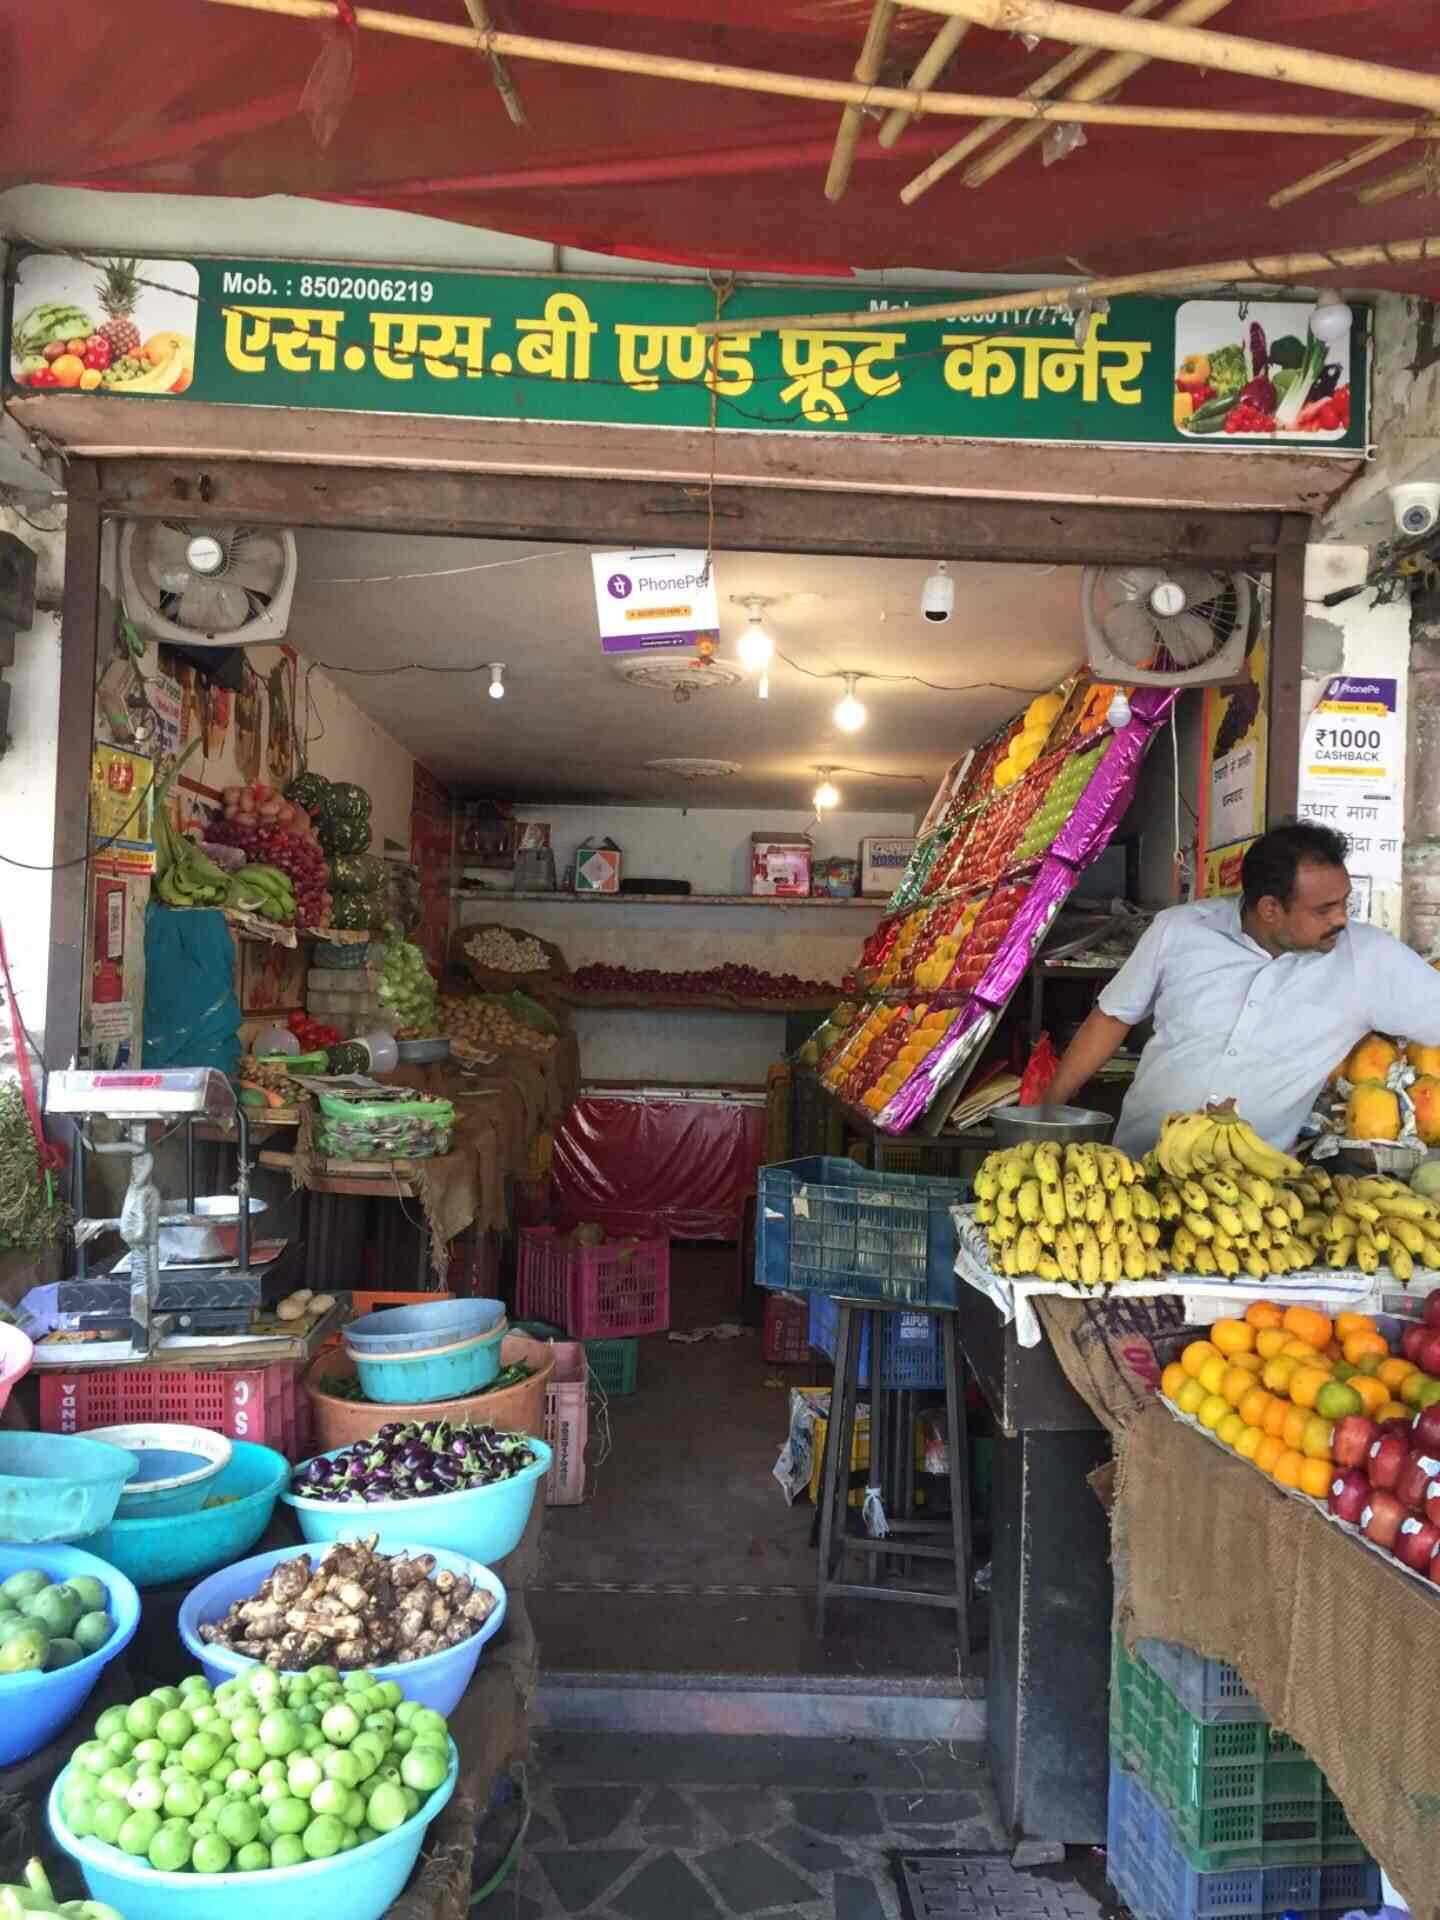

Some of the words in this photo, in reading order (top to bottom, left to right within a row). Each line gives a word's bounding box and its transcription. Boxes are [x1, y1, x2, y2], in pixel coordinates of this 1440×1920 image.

[223, 272, 278, 296] Mob.
[300, 276, 433, 302] 8502006219
[615, 323, 762, 397] एण्ड
[942, 313, 1151, 405] कार्नर
[638, 575, 705, 592] PhonePe
[1315, 728, 1381, 749] ₹1000
[1315, 750, 1380, 761] CASHBACK
[1301, 803, 1338, 819] उधार
